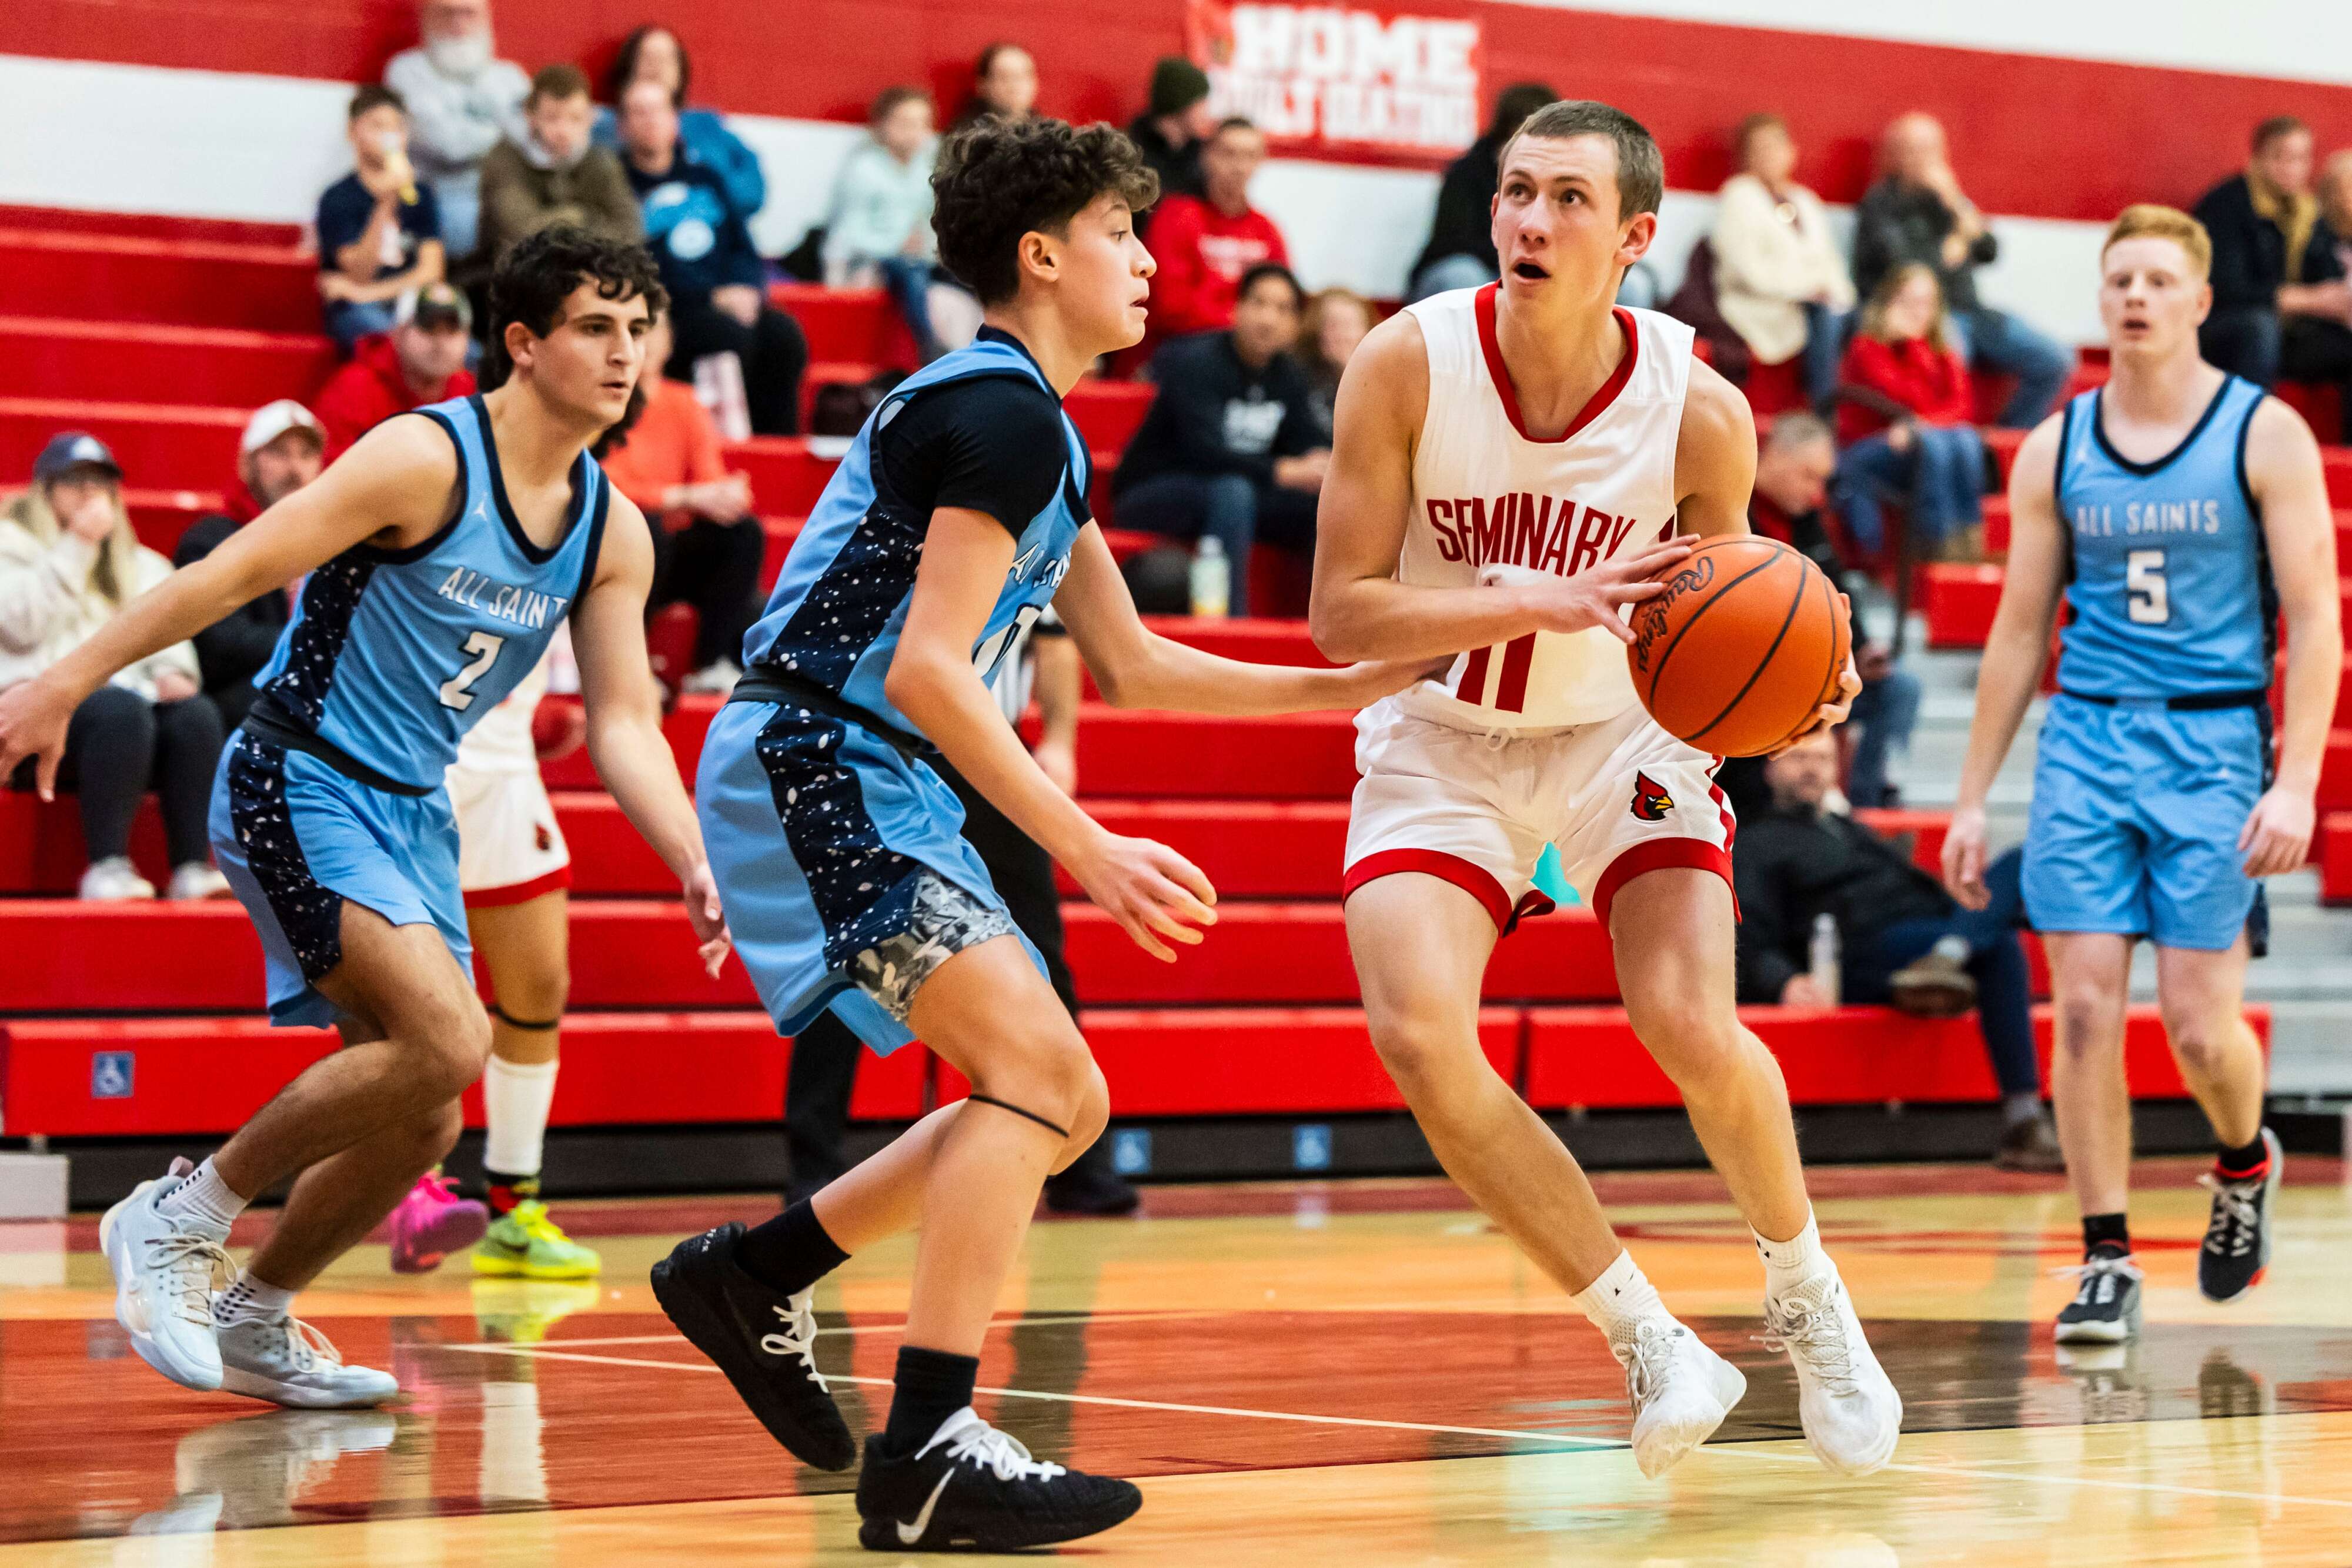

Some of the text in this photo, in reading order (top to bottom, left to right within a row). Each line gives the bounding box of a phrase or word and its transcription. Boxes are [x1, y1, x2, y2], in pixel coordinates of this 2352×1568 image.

[1232, 8, 1476, 87] HOME
[1426, 492, 1636, 577] SEMINARY
[2076, 499, 2220, 536] ALL SAINTS
[438, 566, 569, 629] ALL SAINT
[1637, 556, 1714, 673] Rawlings
[2127, 549, 2169, 624] 5
[439, 630, 506, 711] 2
